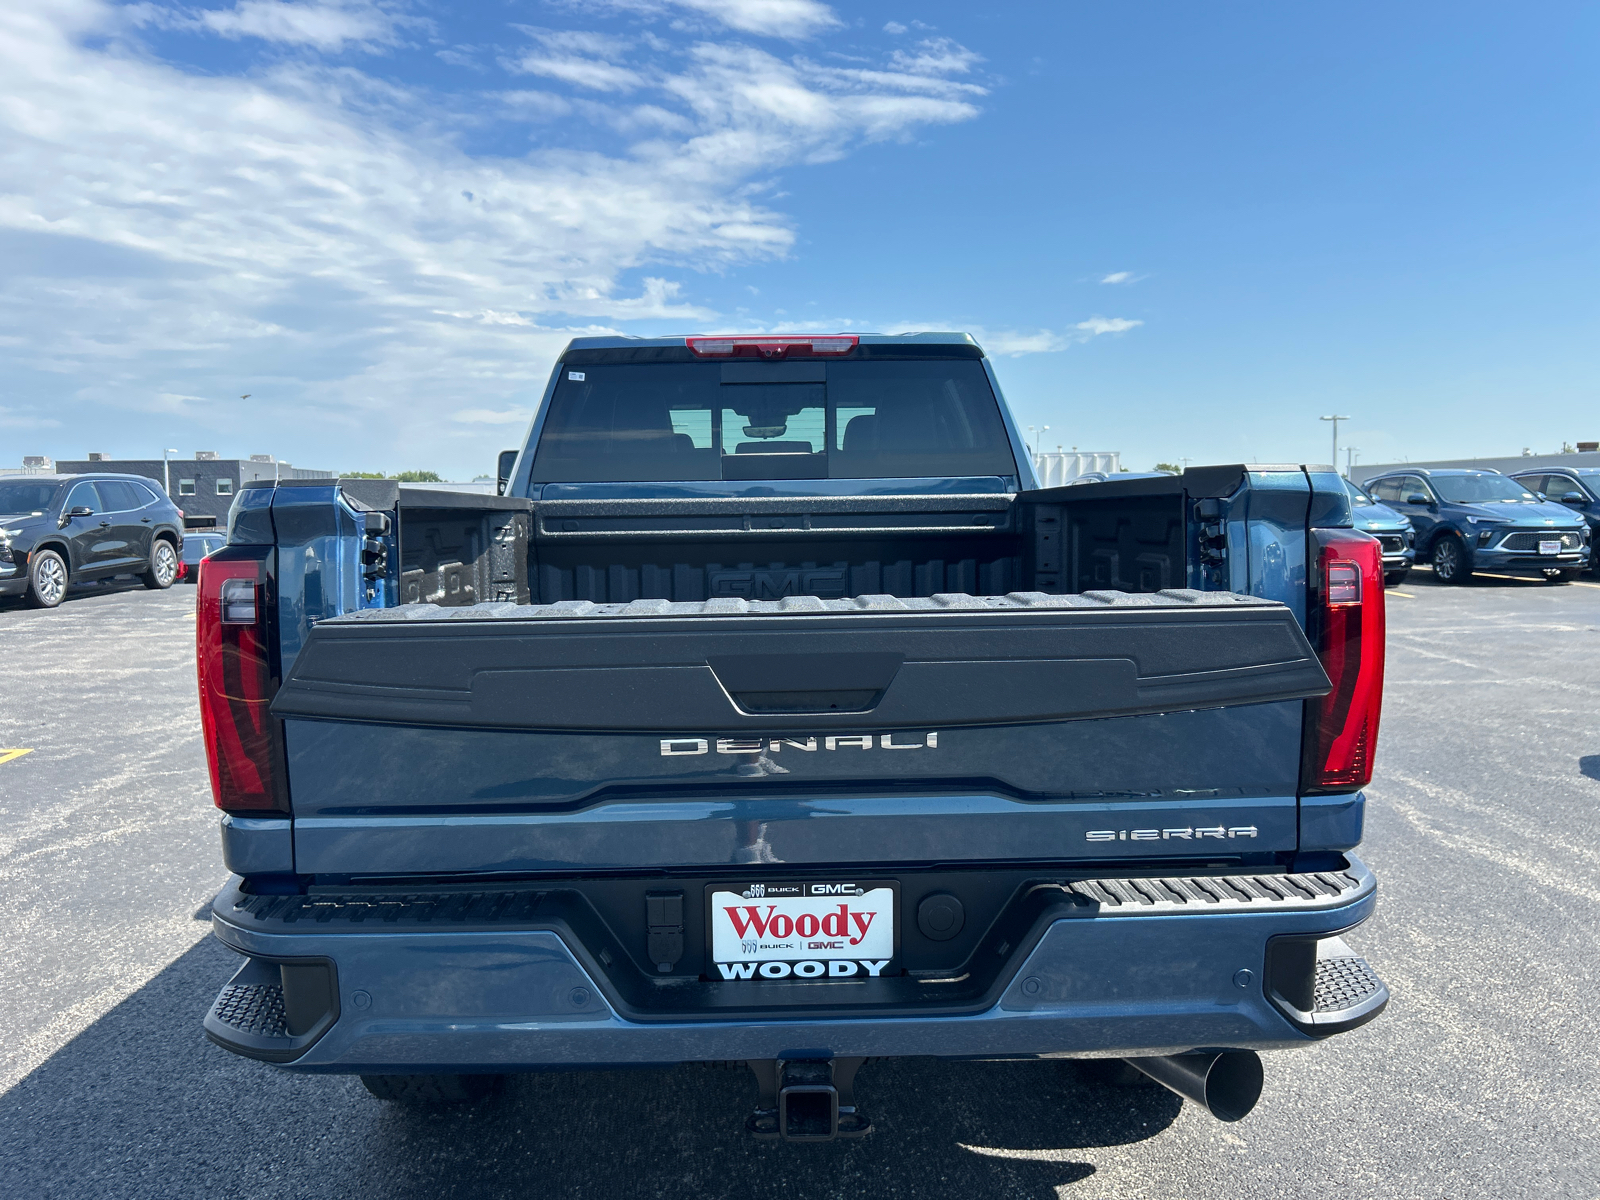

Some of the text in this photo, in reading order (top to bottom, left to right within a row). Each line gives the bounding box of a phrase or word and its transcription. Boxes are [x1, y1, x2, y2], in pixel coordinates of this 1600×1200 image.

[711, 571, 845, 598] GMC
[660, 732, 938, 756] DENALI
[1085, 826, 1258, 842] SIERRA
[811, 883, 856, 894] GMC
[723, 903, 878, 945] Woody
[807, 941, 844, 950] GMC
[717, 960, 891, 980] WOODY
